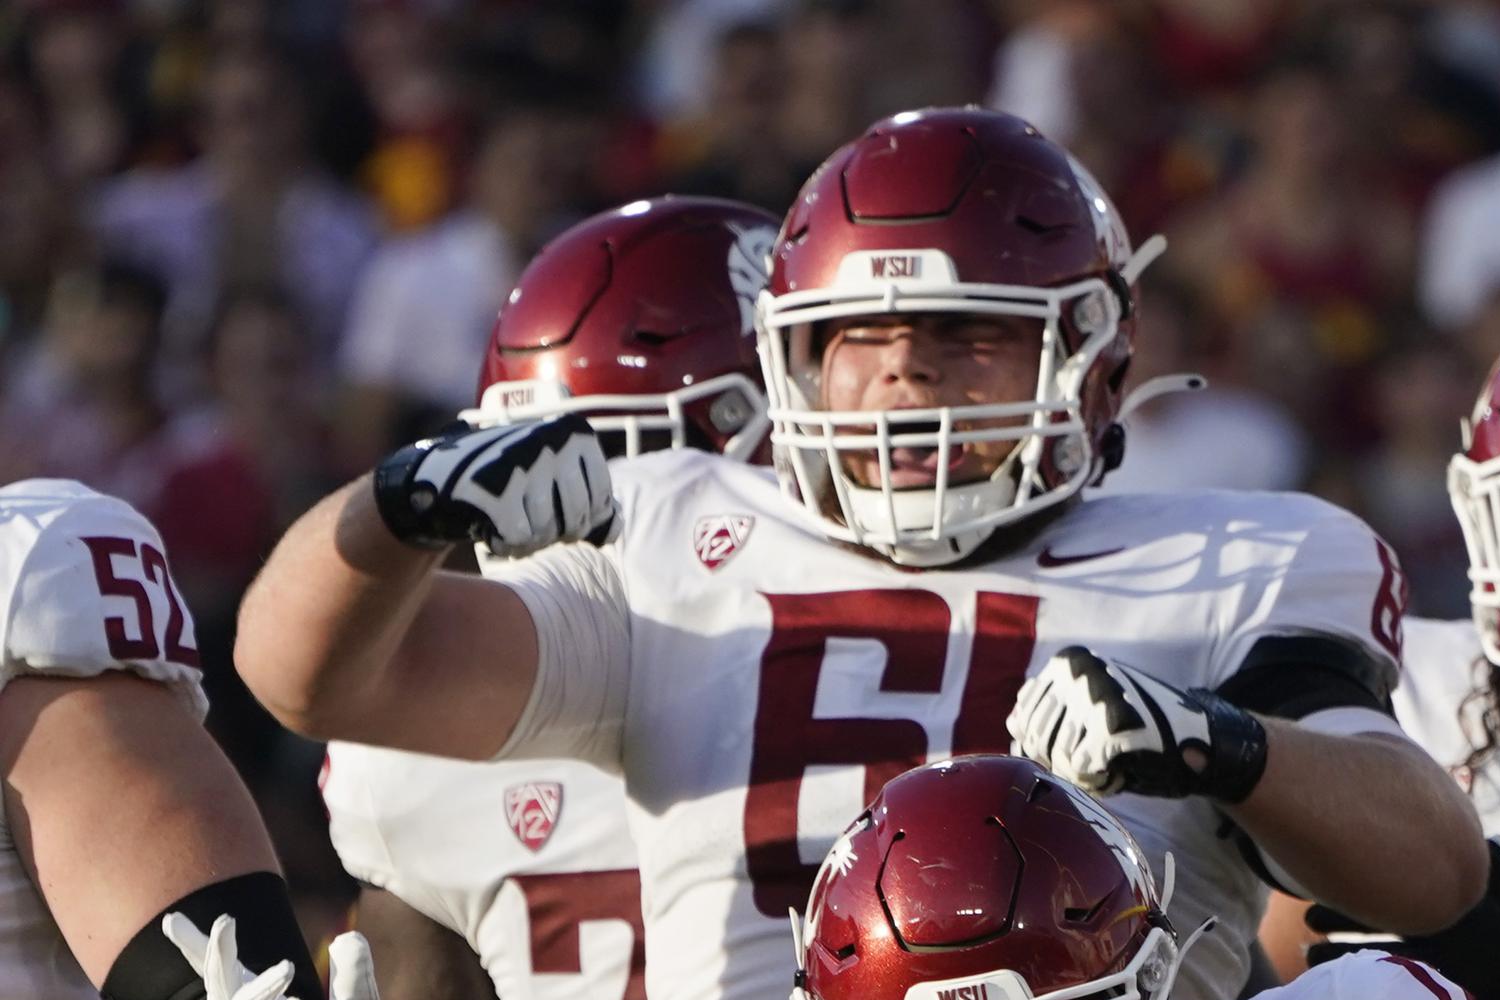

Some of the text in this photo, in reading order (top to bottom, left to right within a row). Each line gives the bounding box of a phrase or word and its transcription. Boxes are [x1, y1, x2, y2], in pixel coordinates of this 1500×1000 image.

[872, 256, 912, 277] WSU
[78, 536, 201, 669] 52
[744, 588, 1040, 918] 61
